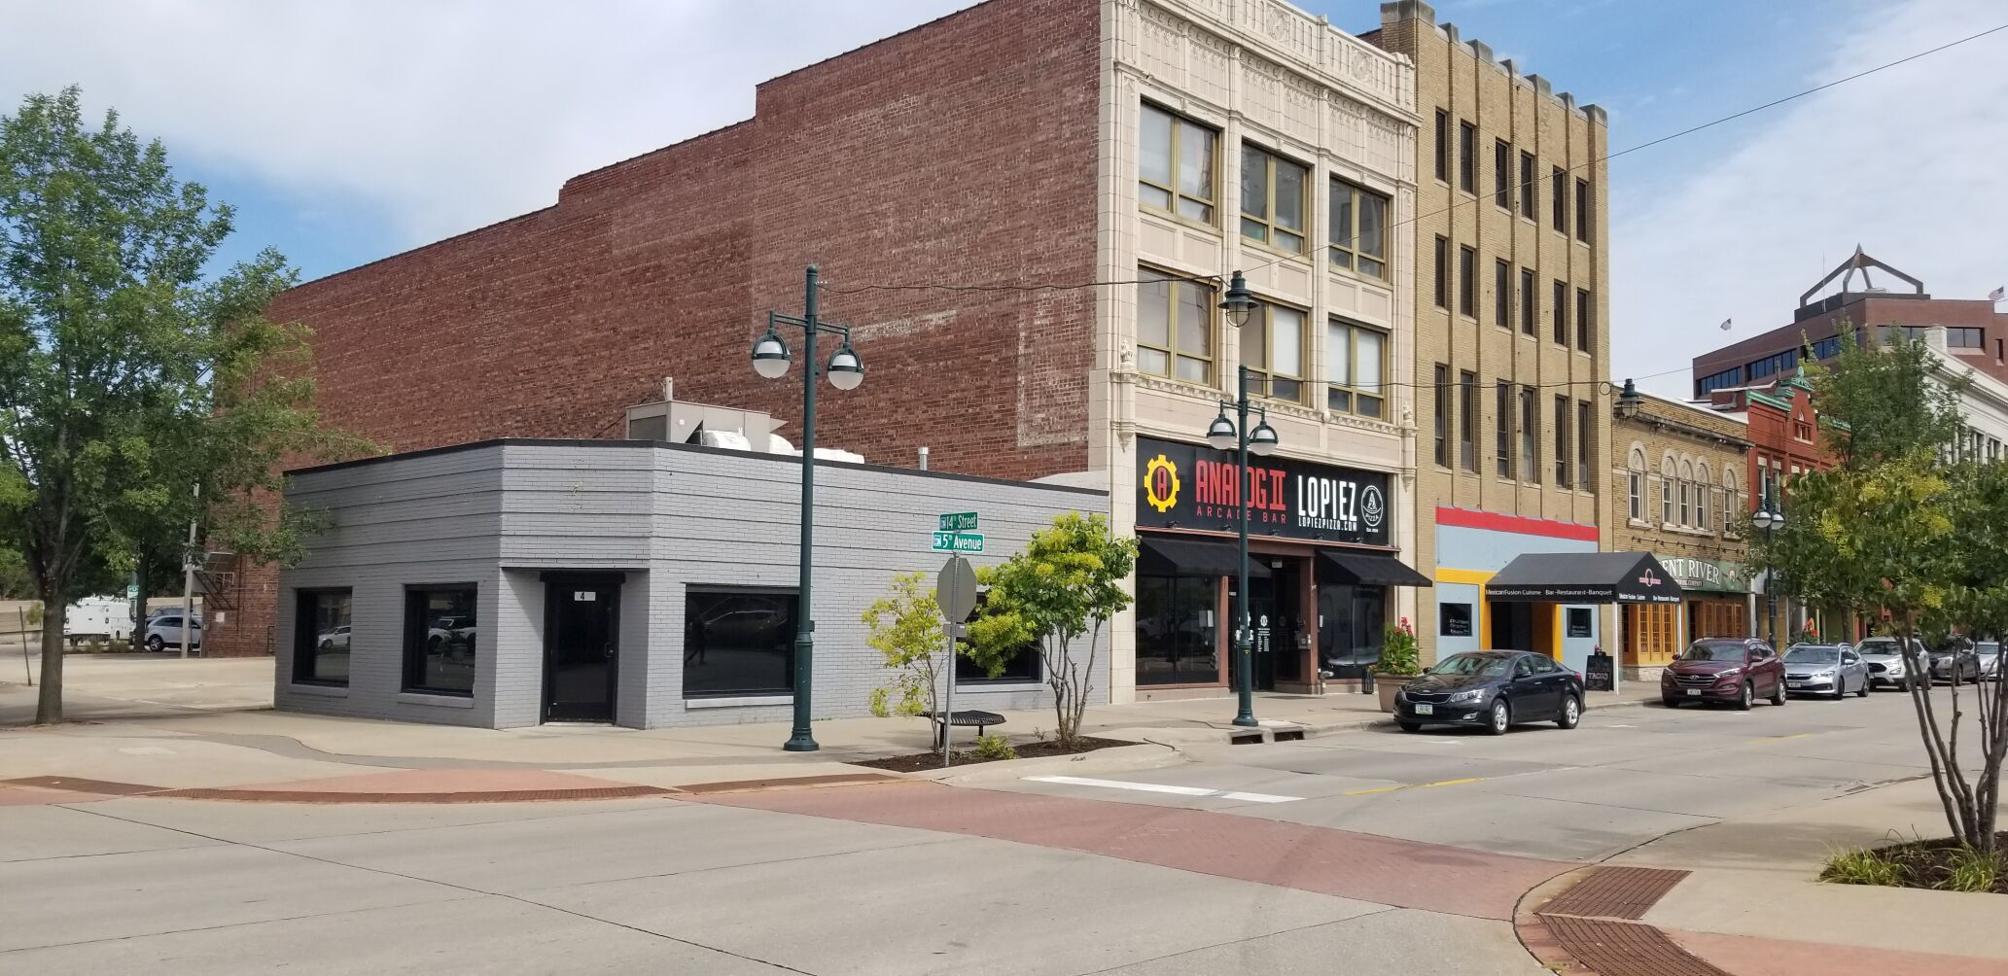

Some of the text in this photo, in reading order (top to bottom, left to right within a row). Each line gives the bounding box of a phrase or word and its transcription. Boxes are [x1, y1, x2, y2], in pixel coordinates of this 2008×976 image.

[1298, 475, 1357, 521] LOPIEZ
[958, 514, 976, 529] Street
[1262, 512, 1286, 524] BAR
[1298, 516, 1357, 531] LOPIEZPIZZA.COM
[954, 535, 982, 550] Avenue
[1661, 559, 1720, 585] ENT RIVER
